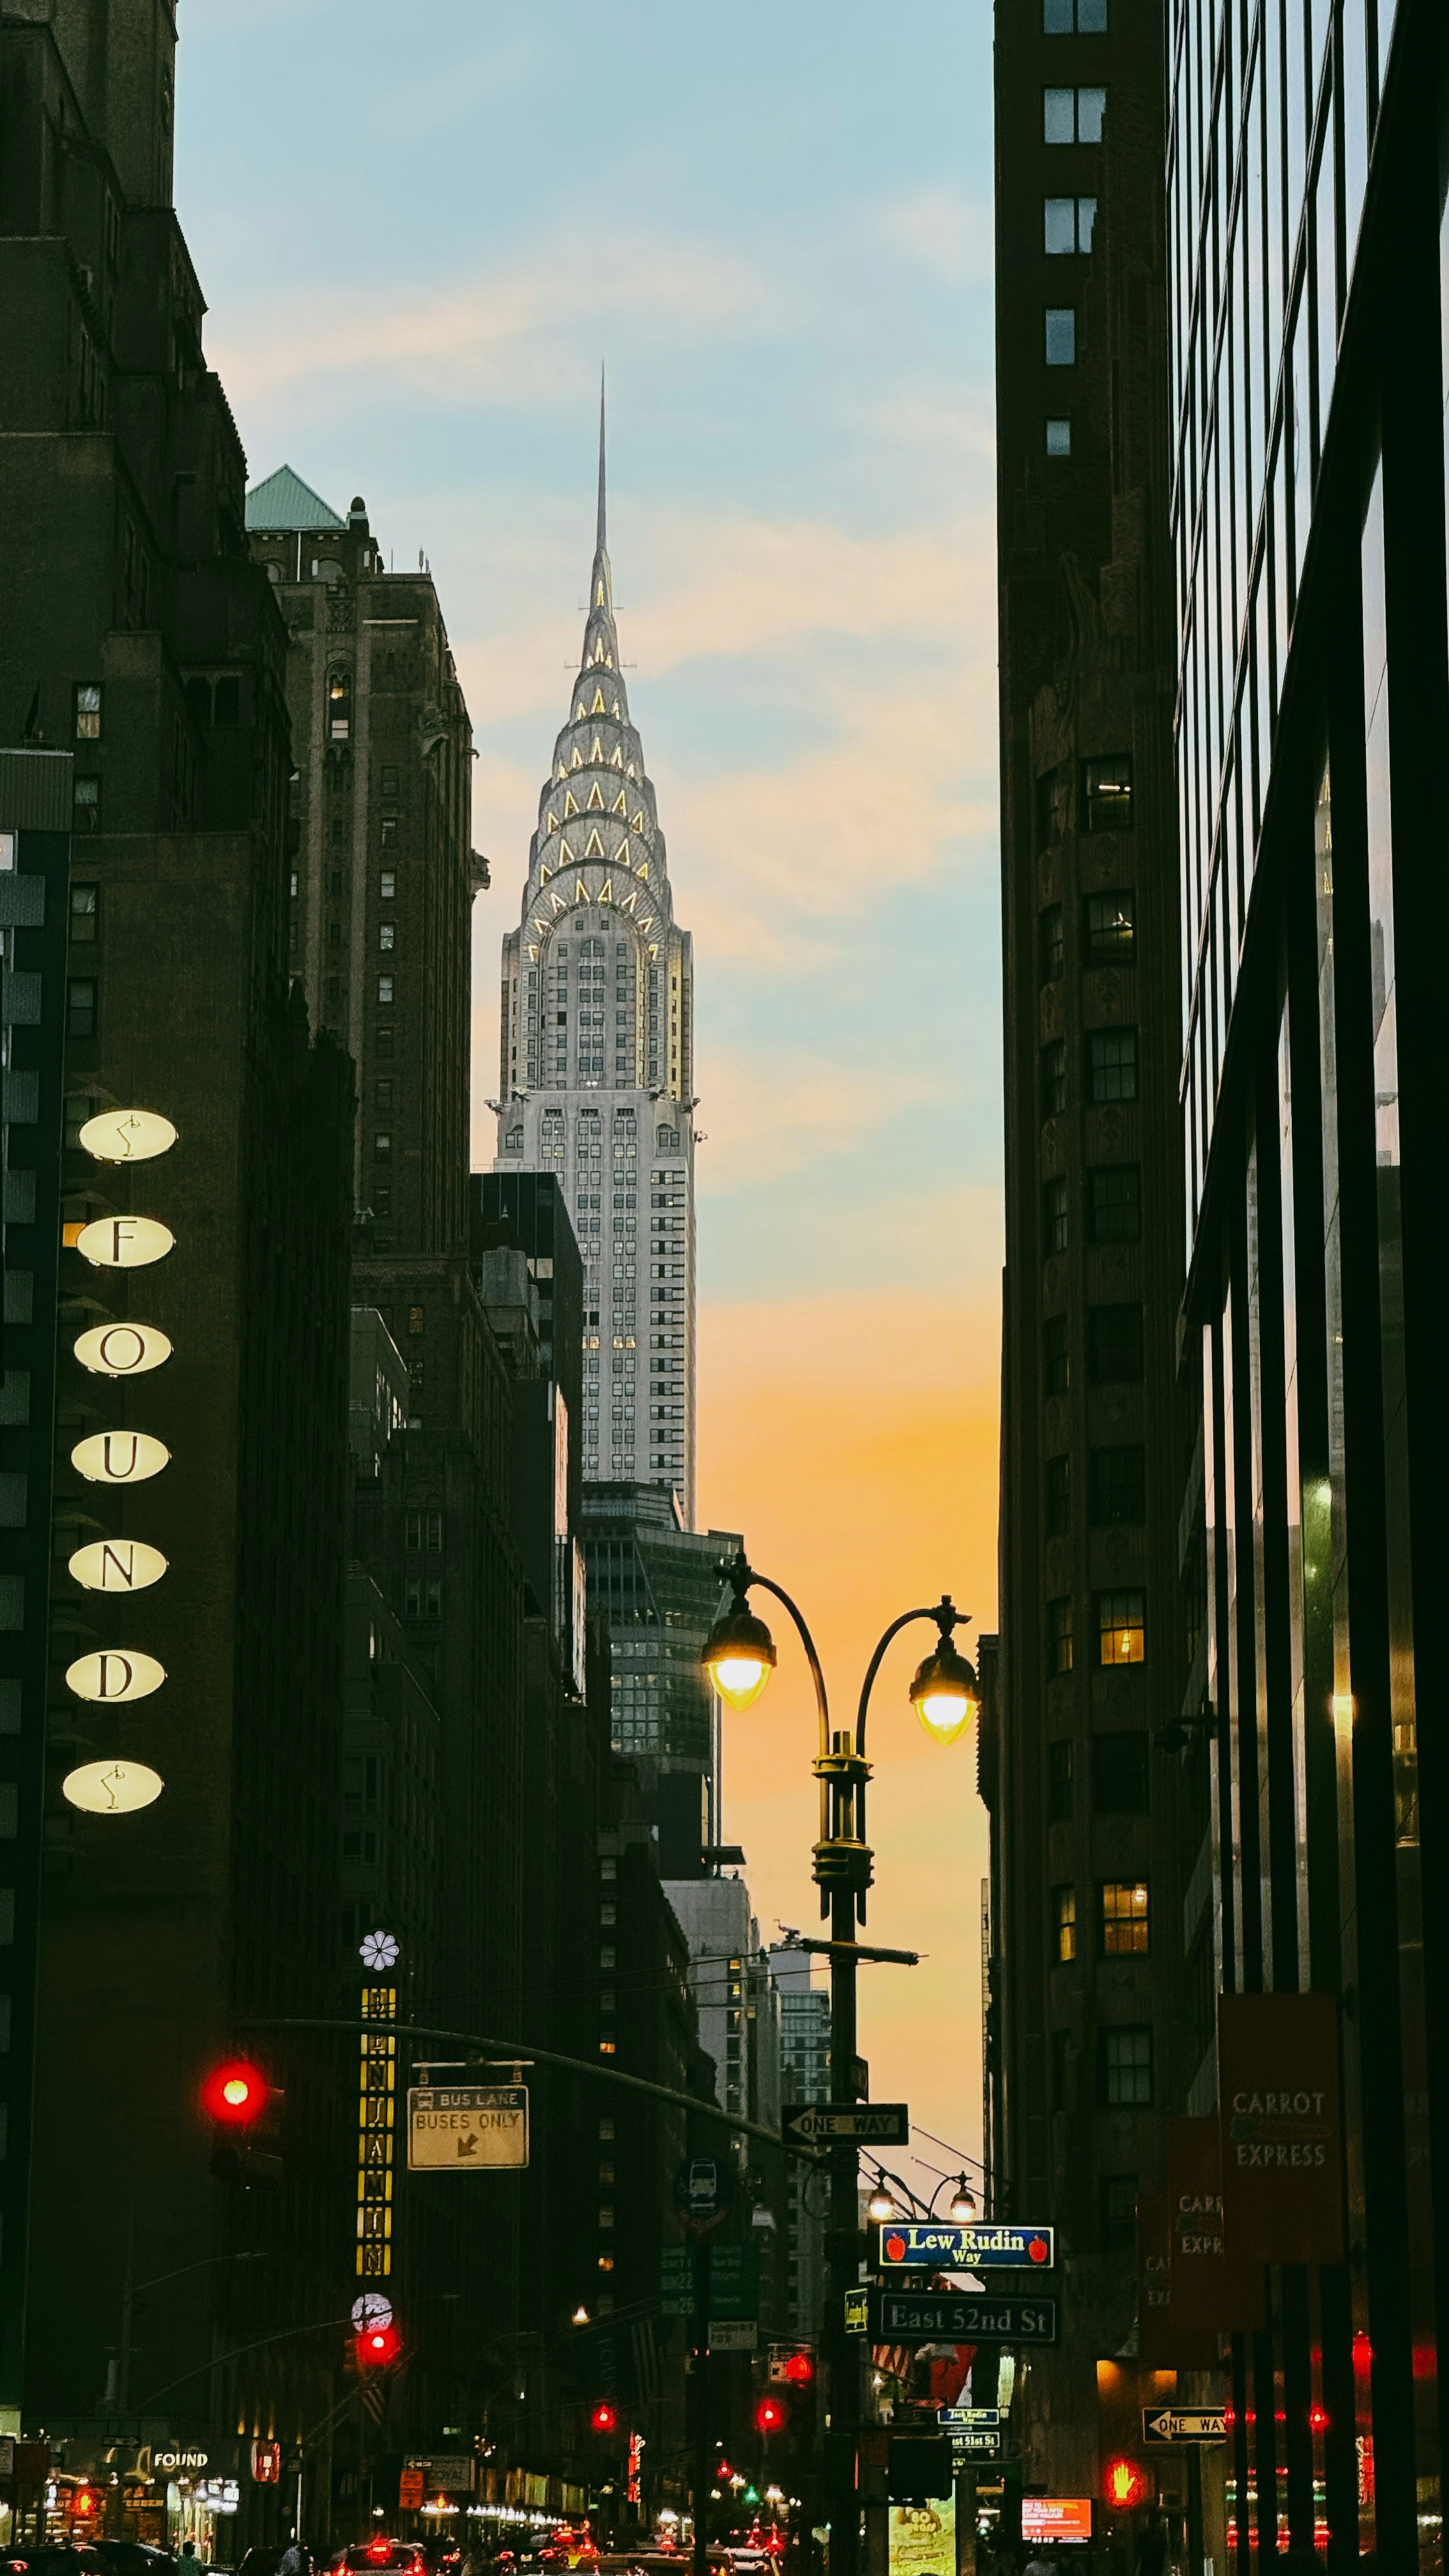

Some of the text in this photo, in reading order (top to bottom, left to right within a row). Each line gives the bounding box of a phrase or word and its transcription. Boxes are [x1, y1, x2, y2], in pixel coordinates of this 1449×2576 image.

[99, 1220, 144, 1698] FOUND
[440, 2093, 518, 2106] BUS LANE
[1232, 2092, 1326, 2115] CARROT
[416, 2113, 520, 2129] BUSES ONLY
[801, 2116, 891, 2133] ONE WAY
[1236, 2145, 1325, 2167] EXPRESS
[1179, 2195, 1223, 2213] CARR
[908, 2229, 1025, 2251] Lew Rudin
[1181, 2236, 1223, 2254] EXPR
[952, 2250, 982, 2264] Way
[890, 2305, 1046, 2332] East 52nd St
[1159, 2419, 1186, 2432] ONE
[965, 2436, 983, 2446] 51st
[985, 2435, 995, 2446] St
[154, 2453, 208, 2467] FOUND
